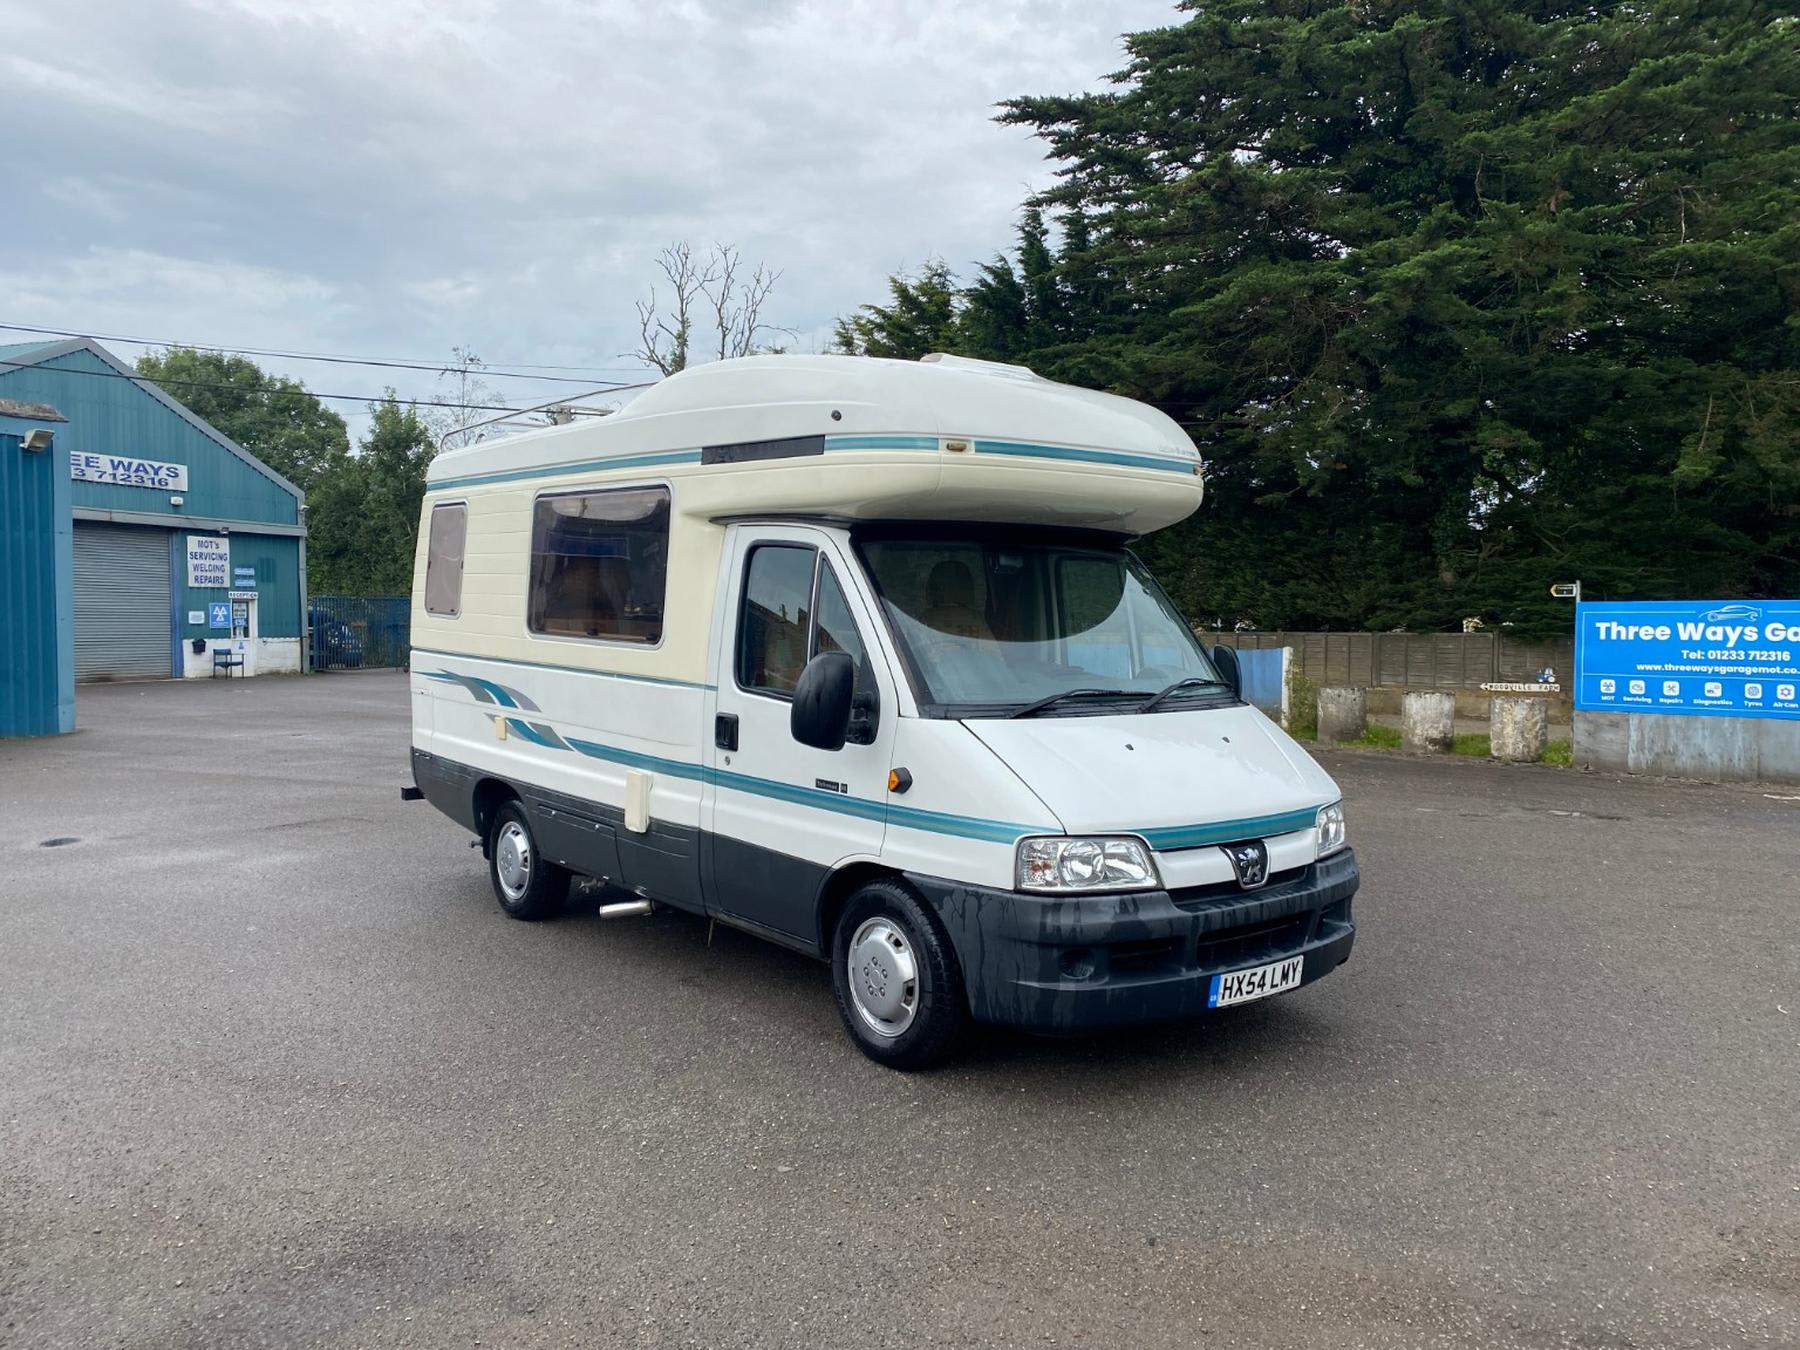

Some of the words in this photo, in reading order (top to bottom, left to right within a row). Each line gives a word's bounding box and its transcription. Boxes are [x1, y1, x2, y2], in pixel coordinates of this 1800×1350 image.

[109, 459, 180, 478] WAYS
[95, 470, 169, 487] 712316
[189, 551, 228, 562] SERVICING
[193, 563, 225, 573] WELDING
[194, 575, 225, 585] REPAIRS
[1595, 621, 1671, 641] Three
[1676, 622, 1759, 648] Ways
[1681, 649, 1704, 660] Tel:
[1707, 650, 1746, 661] 01233
[1747, 650, 1791, 662] 712316
[1693, 698, 1733, 706] Diagnostics
[1744, 700, 1763, 708] Tyres
[1222, 969, 1267, 1001] HX54
[1270, 960, 1300, 990] LMY
